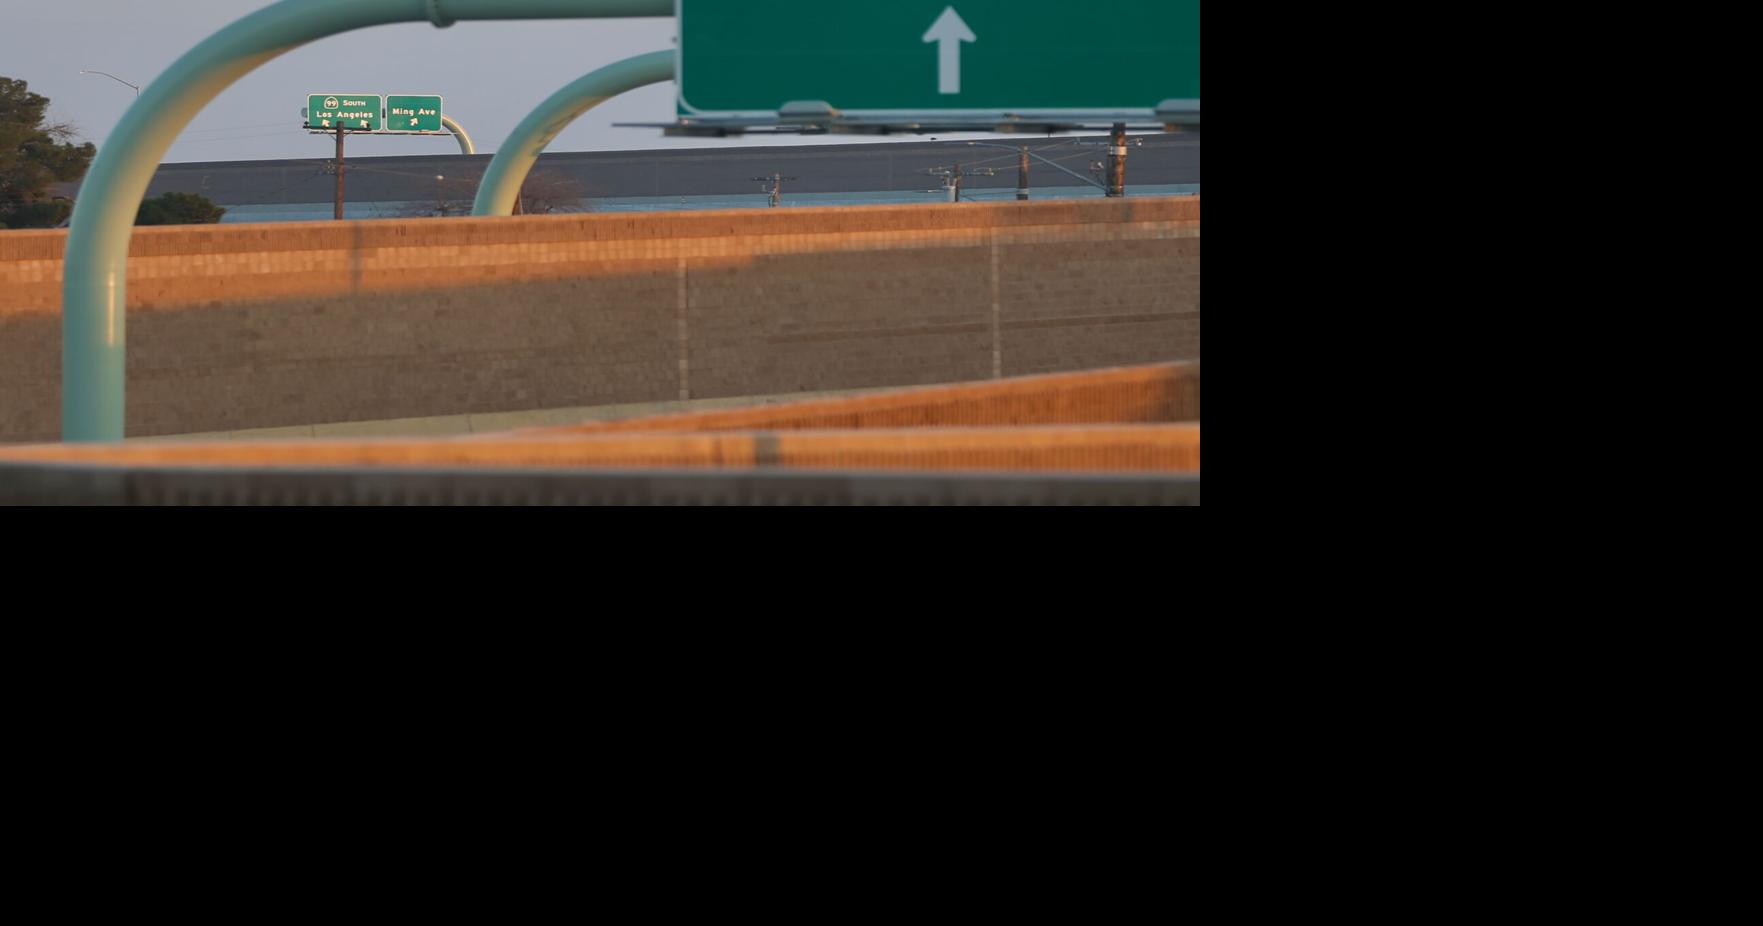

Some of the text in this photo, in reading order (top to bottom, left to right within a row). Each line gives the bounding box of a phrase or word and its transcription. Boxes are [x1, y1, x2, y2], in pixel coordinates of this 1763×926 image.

[336, 111, 374, 119] Angeles
[392, 108, 436, 116] Ming Ave
